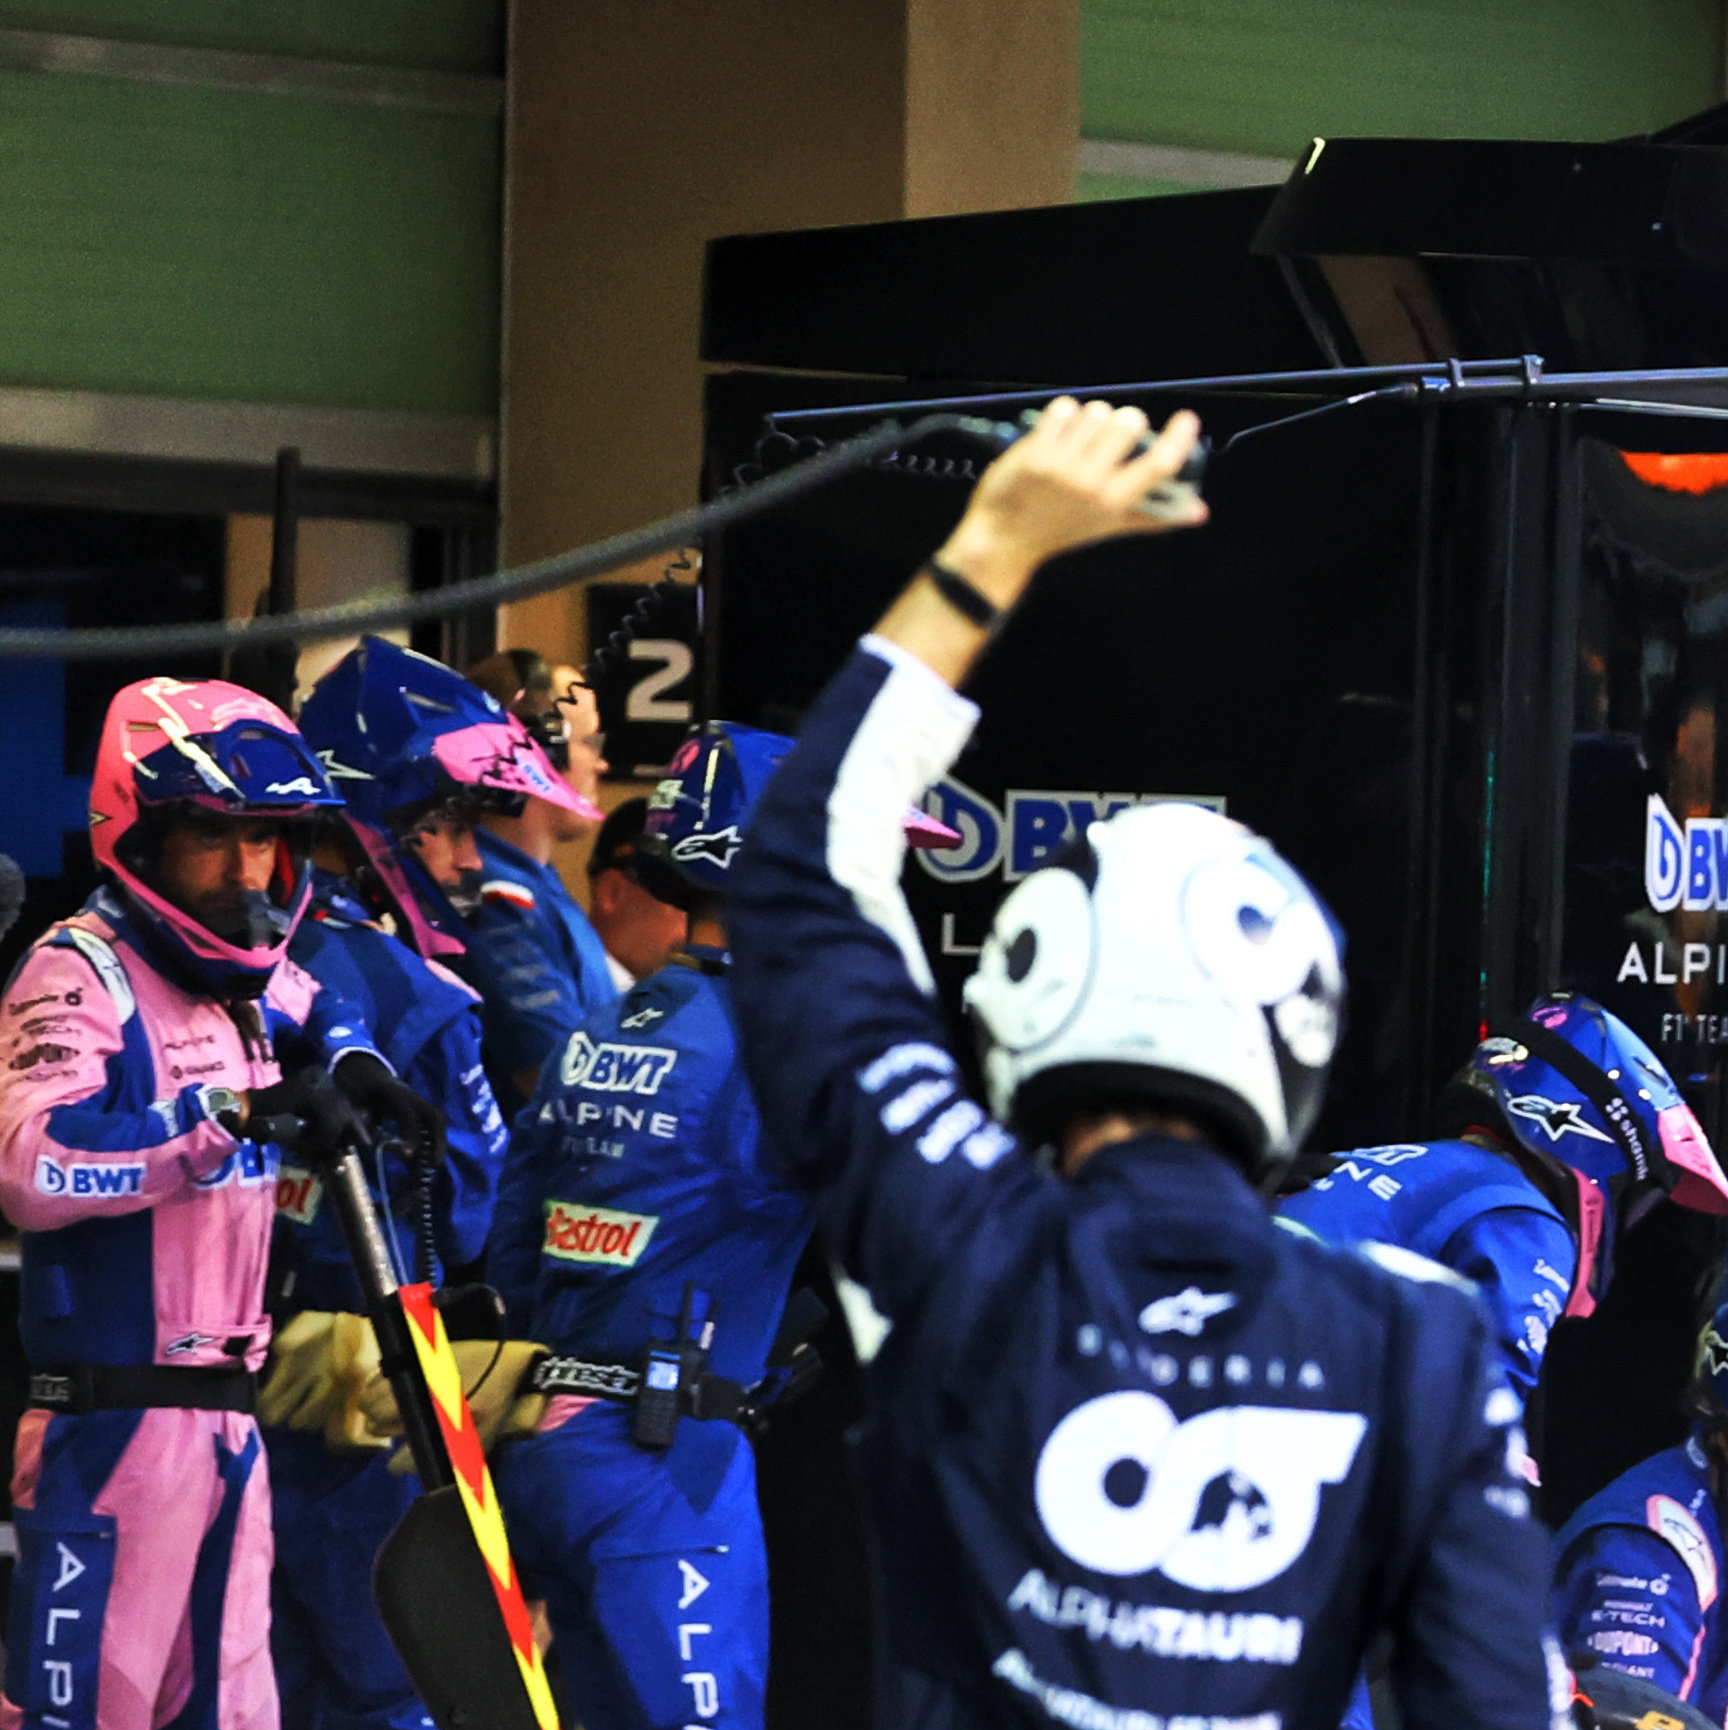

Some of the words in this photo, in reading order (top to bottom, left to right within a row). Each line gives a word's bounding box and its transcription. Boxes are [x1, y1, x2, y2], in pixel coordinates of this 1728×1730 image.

[590, 1044, 677, 1093] BWT
[538, 1098, 680, 1139] ALPINE
[73, 1164, 146, 1197] BWT
